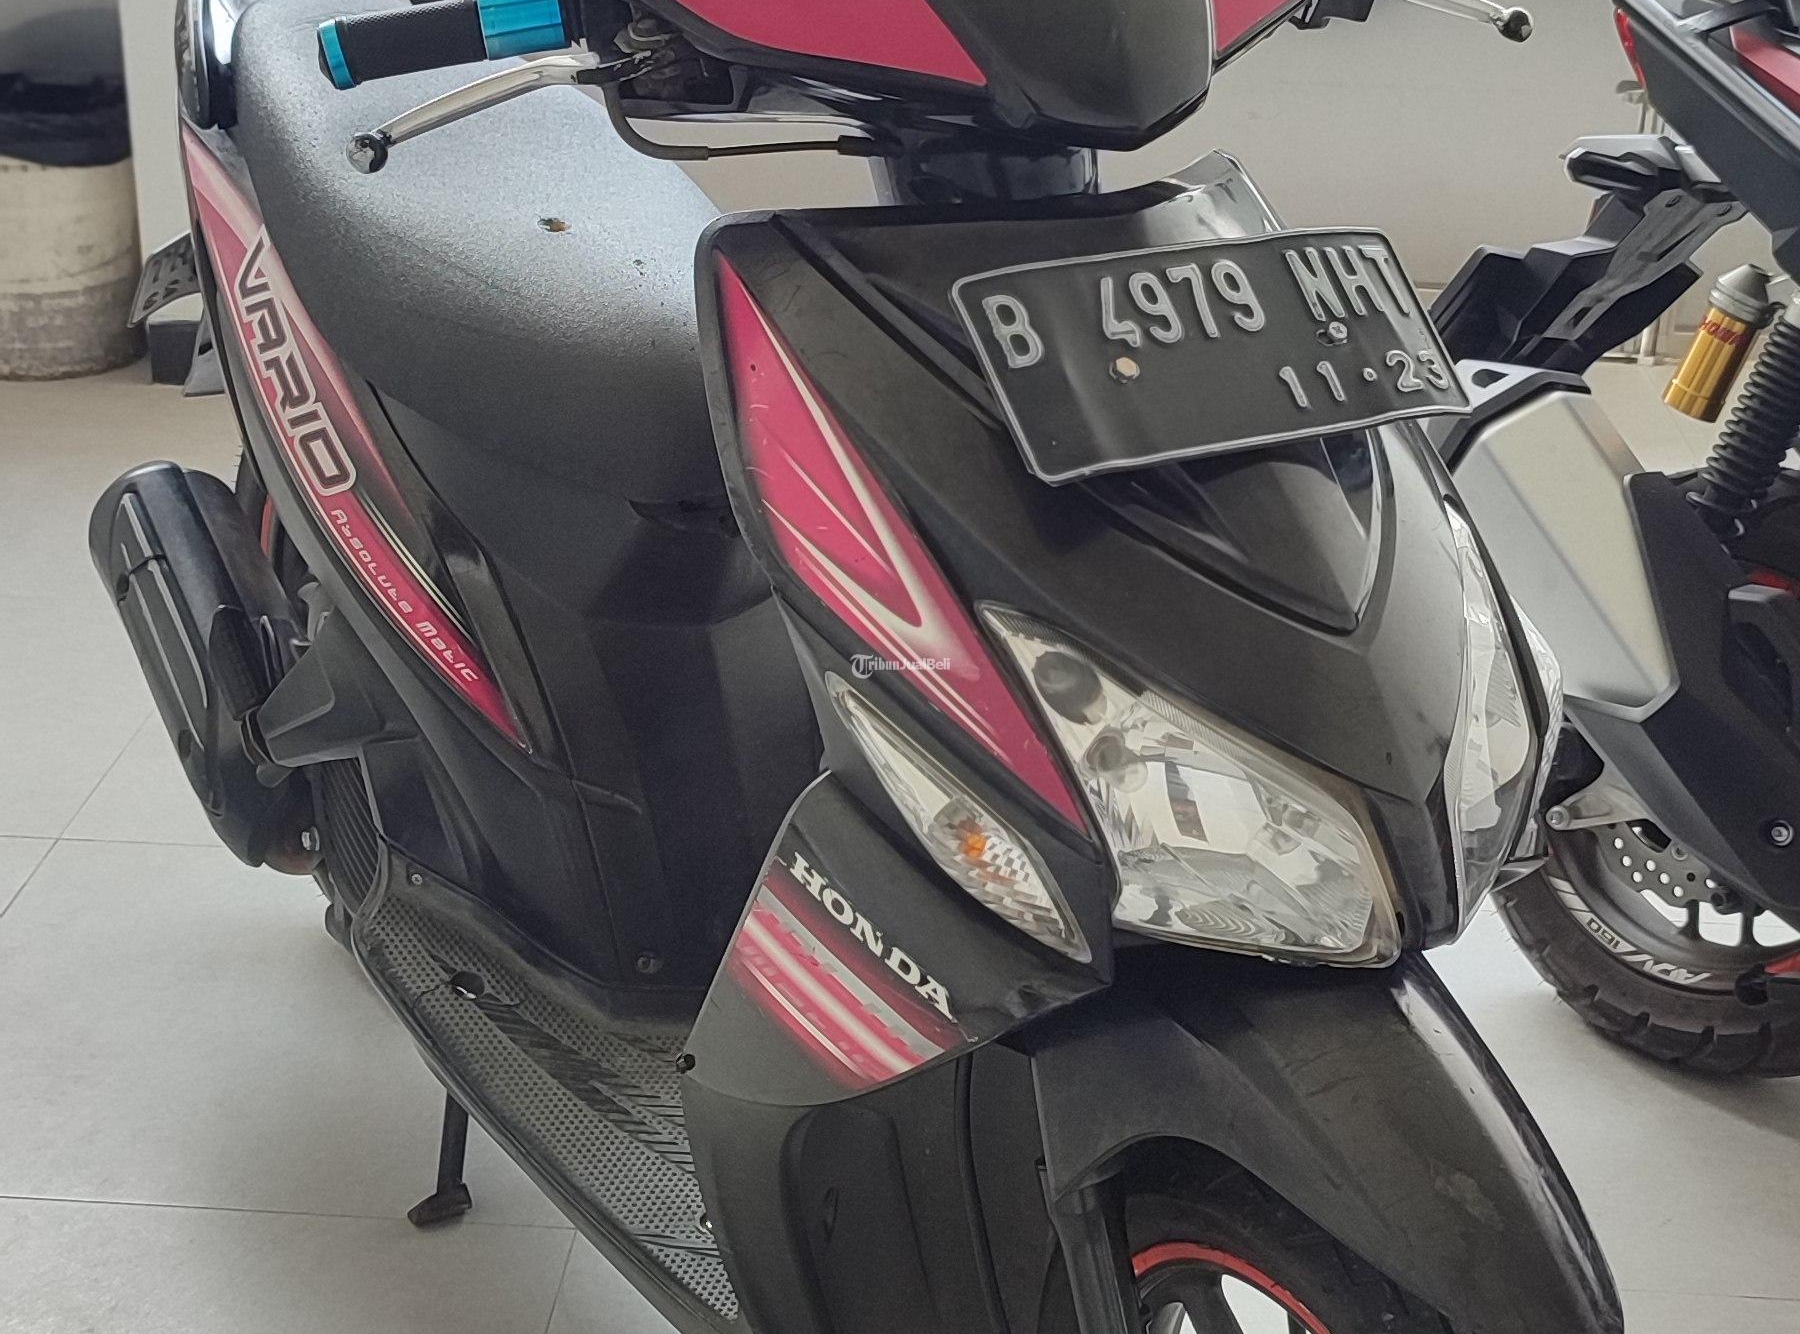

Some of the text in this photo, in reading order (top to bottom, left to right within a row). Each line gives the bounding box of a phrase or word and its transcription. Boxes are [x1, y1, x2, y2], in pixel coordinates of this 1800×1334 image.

[236, 226, 356, 495] VARIO
[982, 246, 1410, 368] B 4979 NHT
[789, 851, 955, 1021] HONDA
[1586, 917, 1622, 950] 160
